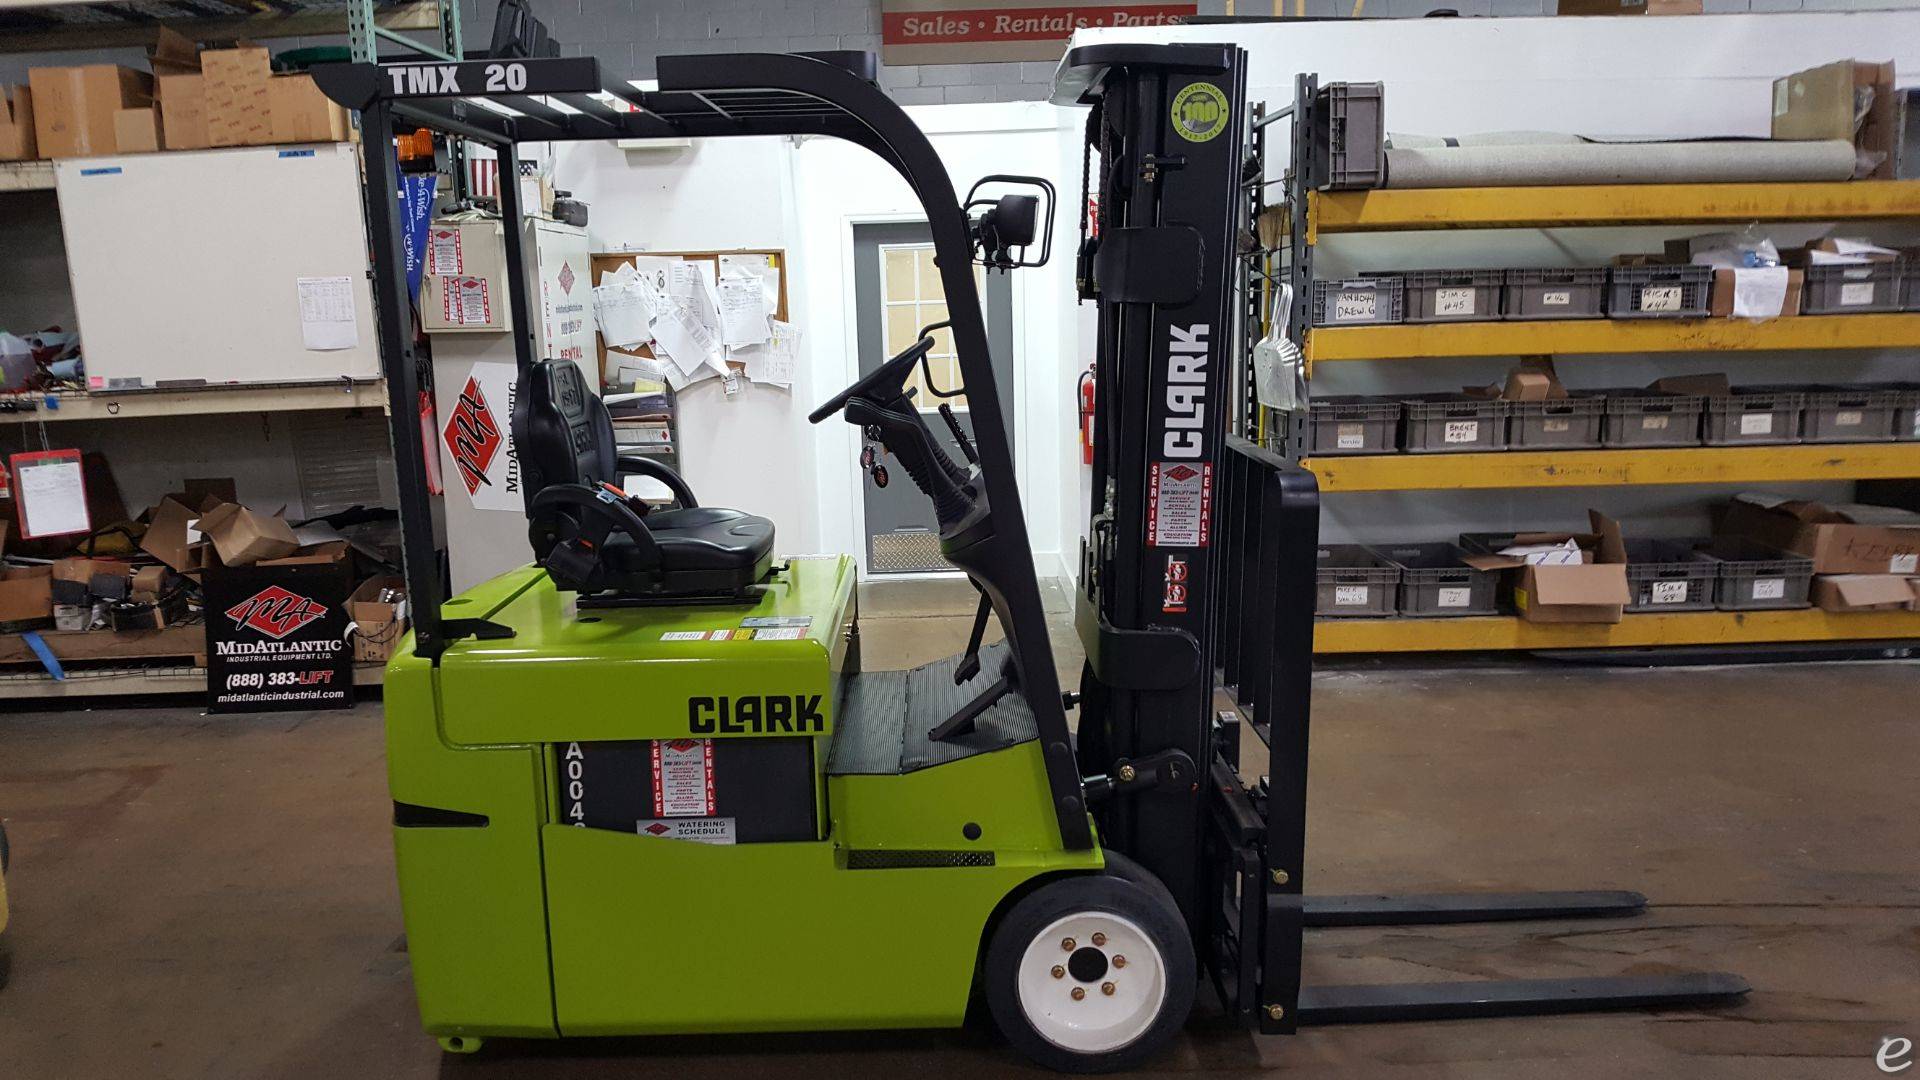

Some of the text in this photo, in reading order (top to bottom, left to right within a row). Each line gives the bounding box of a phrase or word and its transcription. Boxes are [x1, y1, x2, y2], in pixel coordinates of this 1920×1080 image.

[903, 11, 1180, 37] Sales Rentals Parts
[387, 63, 527, 95] TMX 20
[1163, 323, 1210, 458] CLARK
[1148, 465, 1158, 541] SERVICE
[1200, 466, 1211, 542] RENTALS
[216, 640, 342, 656] MIDATLANTIC
[226, 655, 271, 663] INDUSTRIAL
[272, 653, 315, 661] EQUIPMENT
[217, 690, 345, 703] midatlanticindustrial.com
[226, 670, 334, 690] (888) 383-LIFT
[688, 694, 824, 734] CLARK
[565, 742, 586, 828] A004
[652, 739, 662, 812] SERVICE
